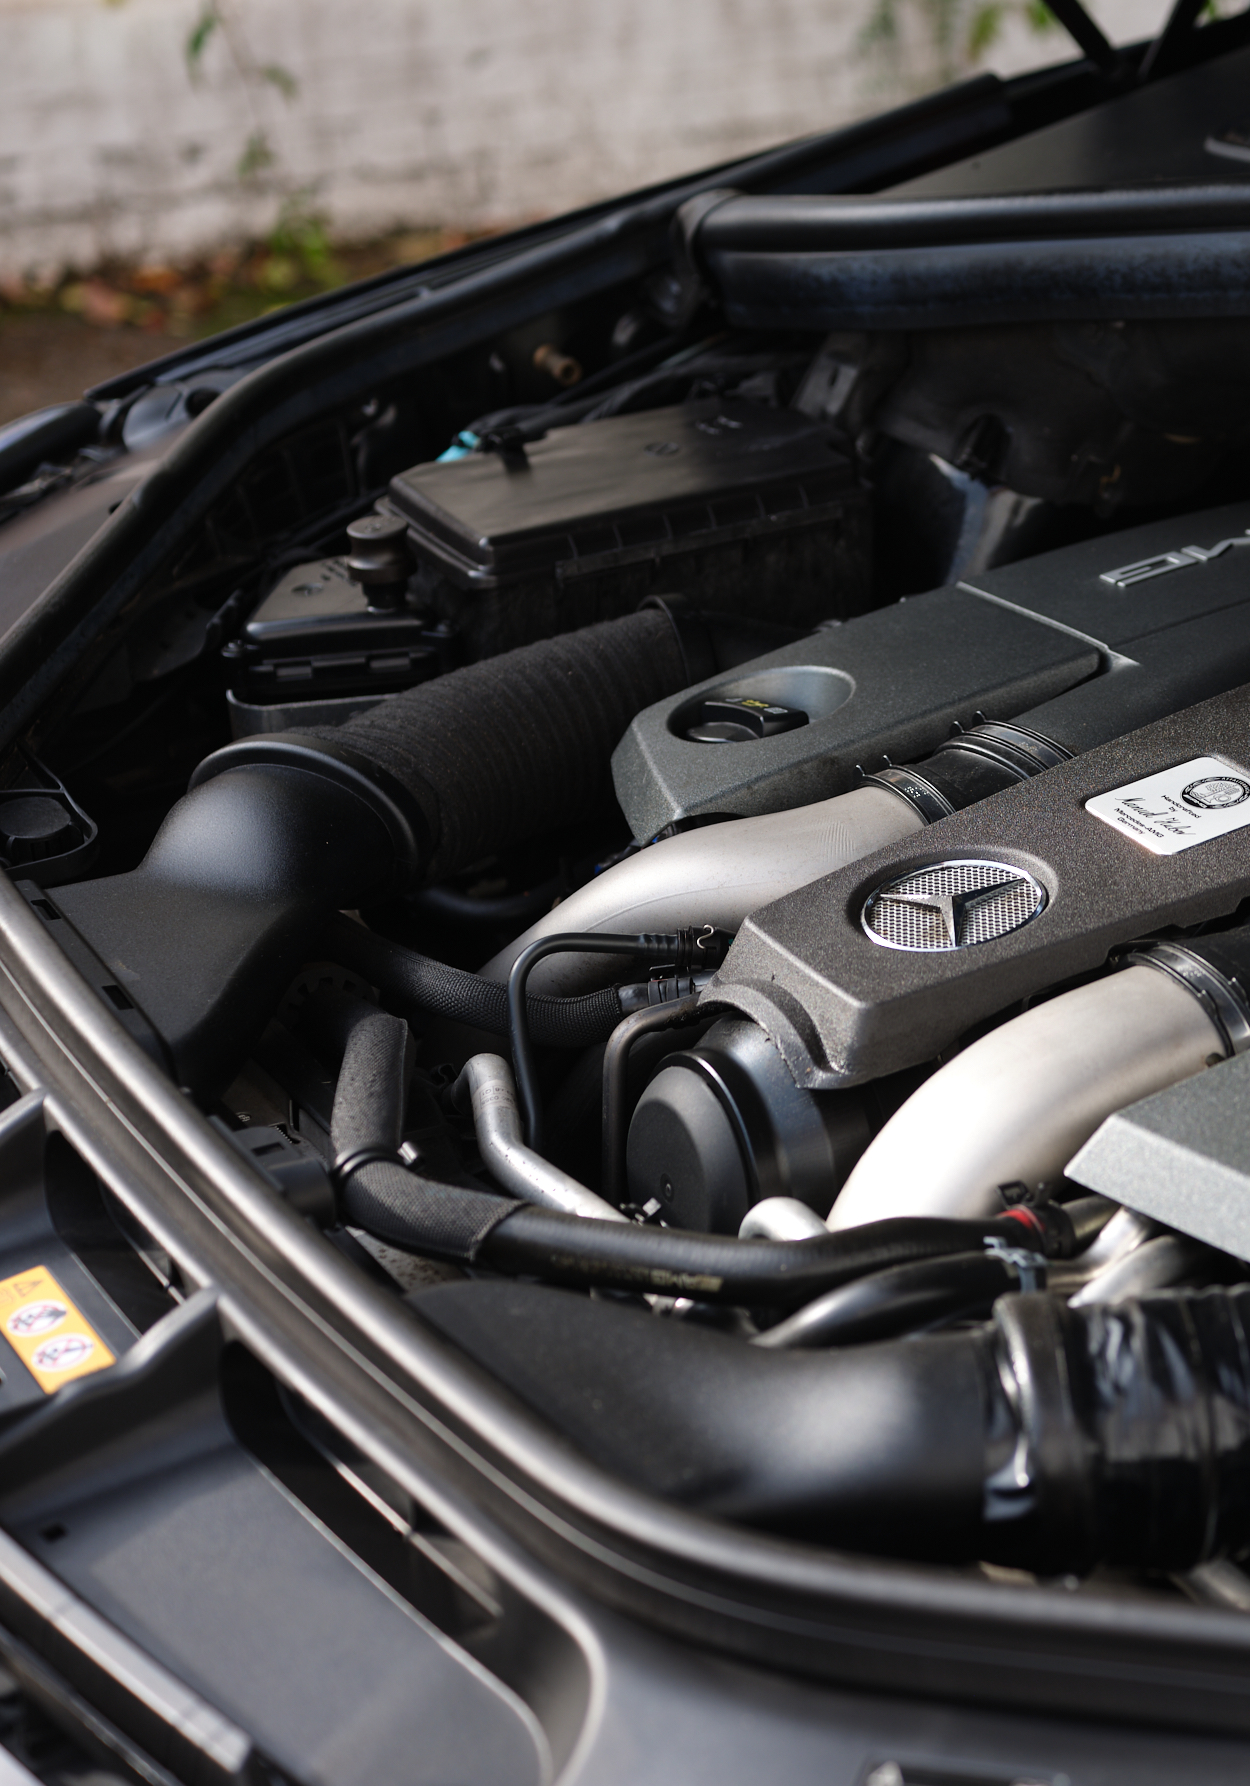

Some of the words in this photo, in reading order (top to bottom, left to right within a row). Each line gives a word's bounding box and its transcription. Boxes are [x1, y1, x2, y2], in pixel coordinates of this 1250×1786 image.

[1161, 794, 1201, 819] Handcrafted
[1114, 807, 1164, 838] Mercedes-AMG
[1117, 816, 1145, 835] Germany
